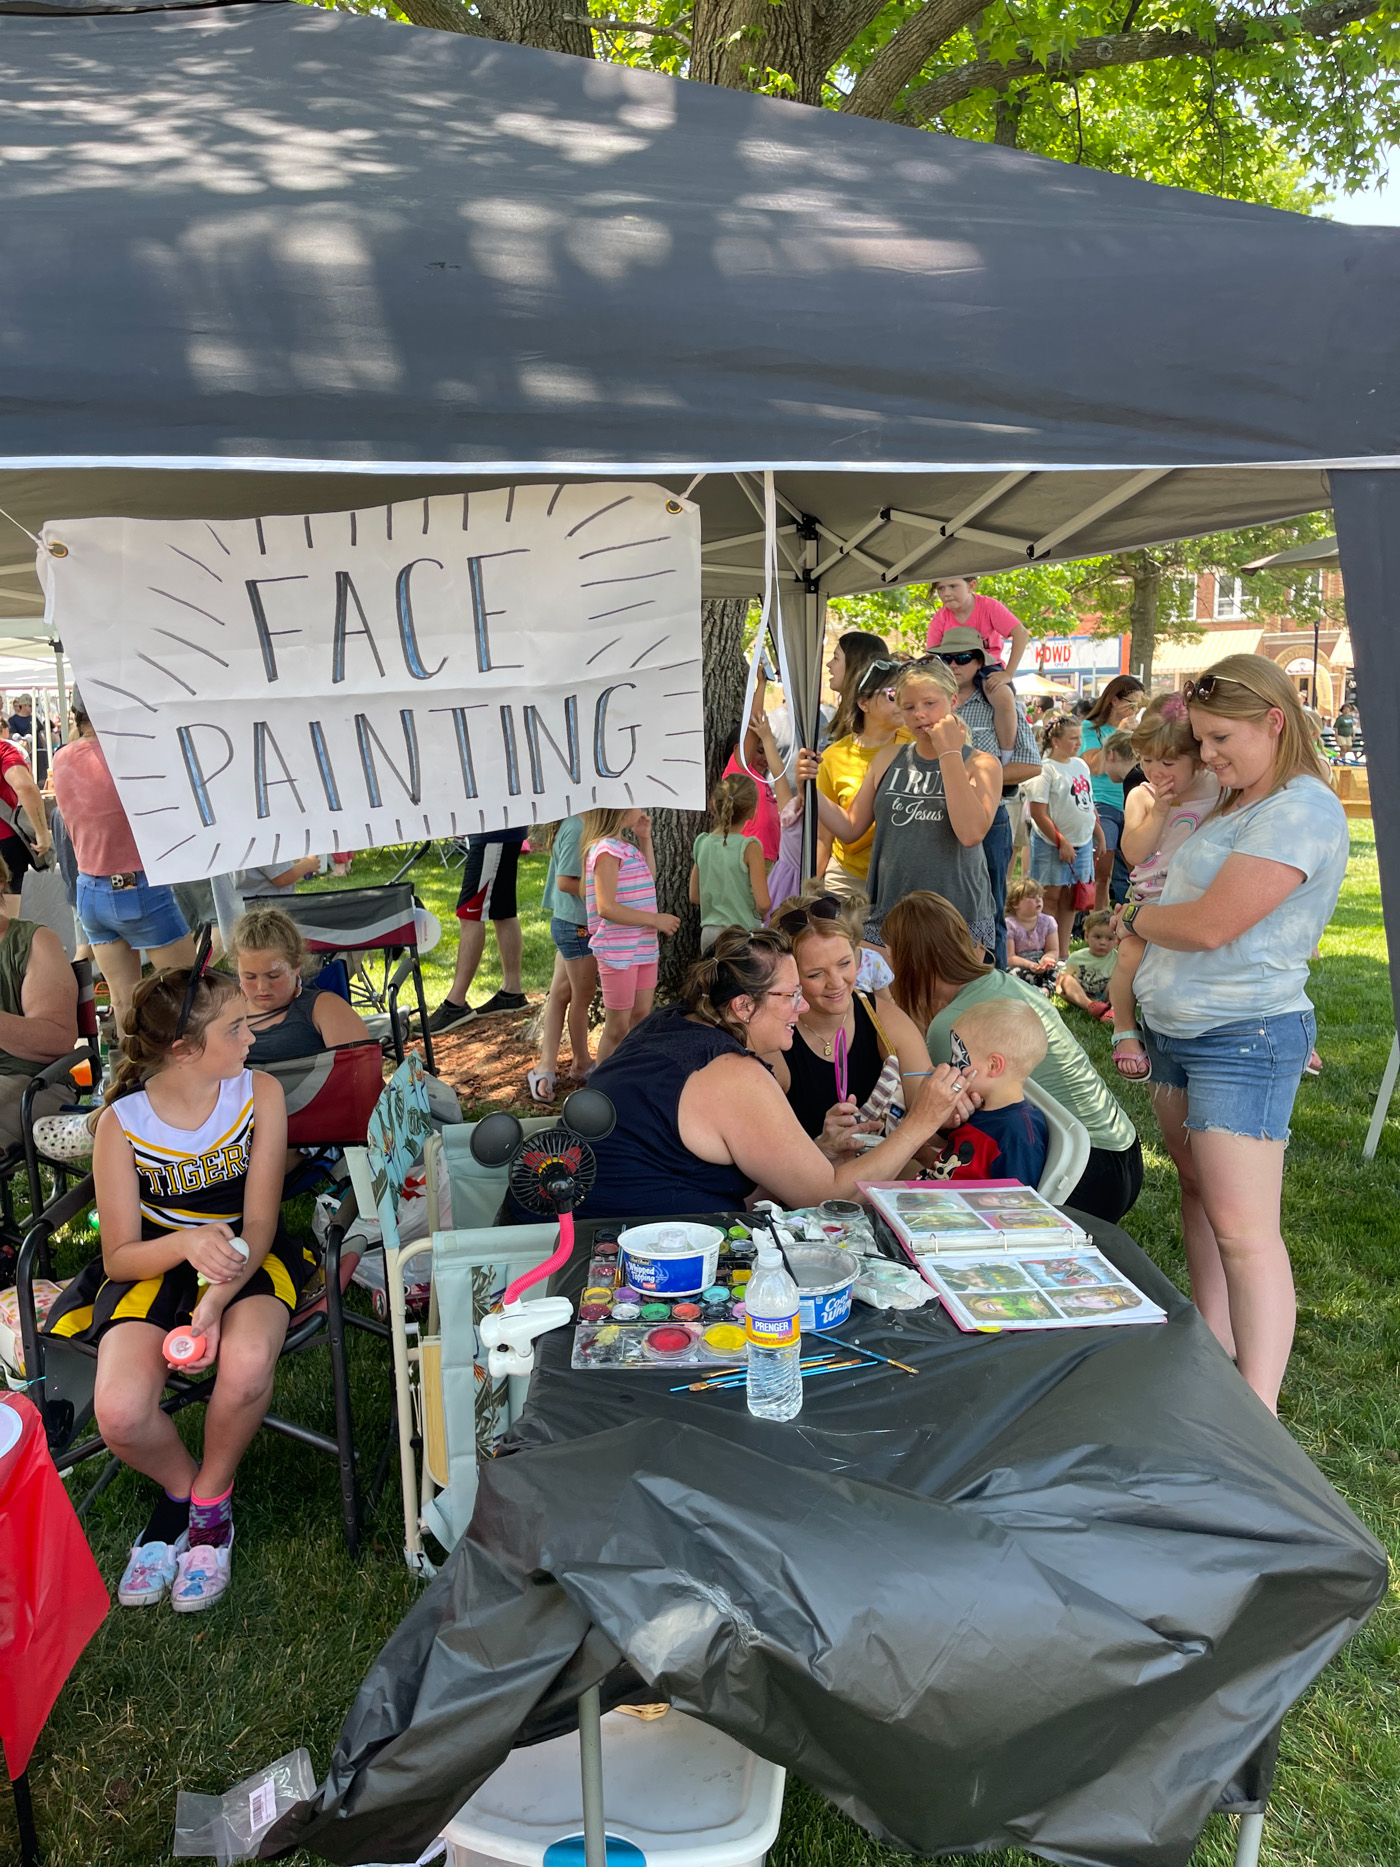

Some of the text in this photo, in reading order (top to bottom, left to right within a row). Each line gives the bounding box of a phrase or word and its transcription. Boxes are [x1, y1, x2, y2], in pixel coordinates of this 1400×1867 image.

[245, 548, 531, 683] FACE
[177, 682, 642, 827] PAINTING
[886, 767, 903, 791] I
[891, 797, 944, 827] to Jesus
[136, 1138, 251, 1197] TIGER
[628, 1261, 655, 1276] Whipped
[631, 1270, 655, 1284] Topping
[821, 1301, 851, 1324] Whip
[825, 1290, 849, 1312] Cool
[755, 1320, 789, 1332] PRENGER
